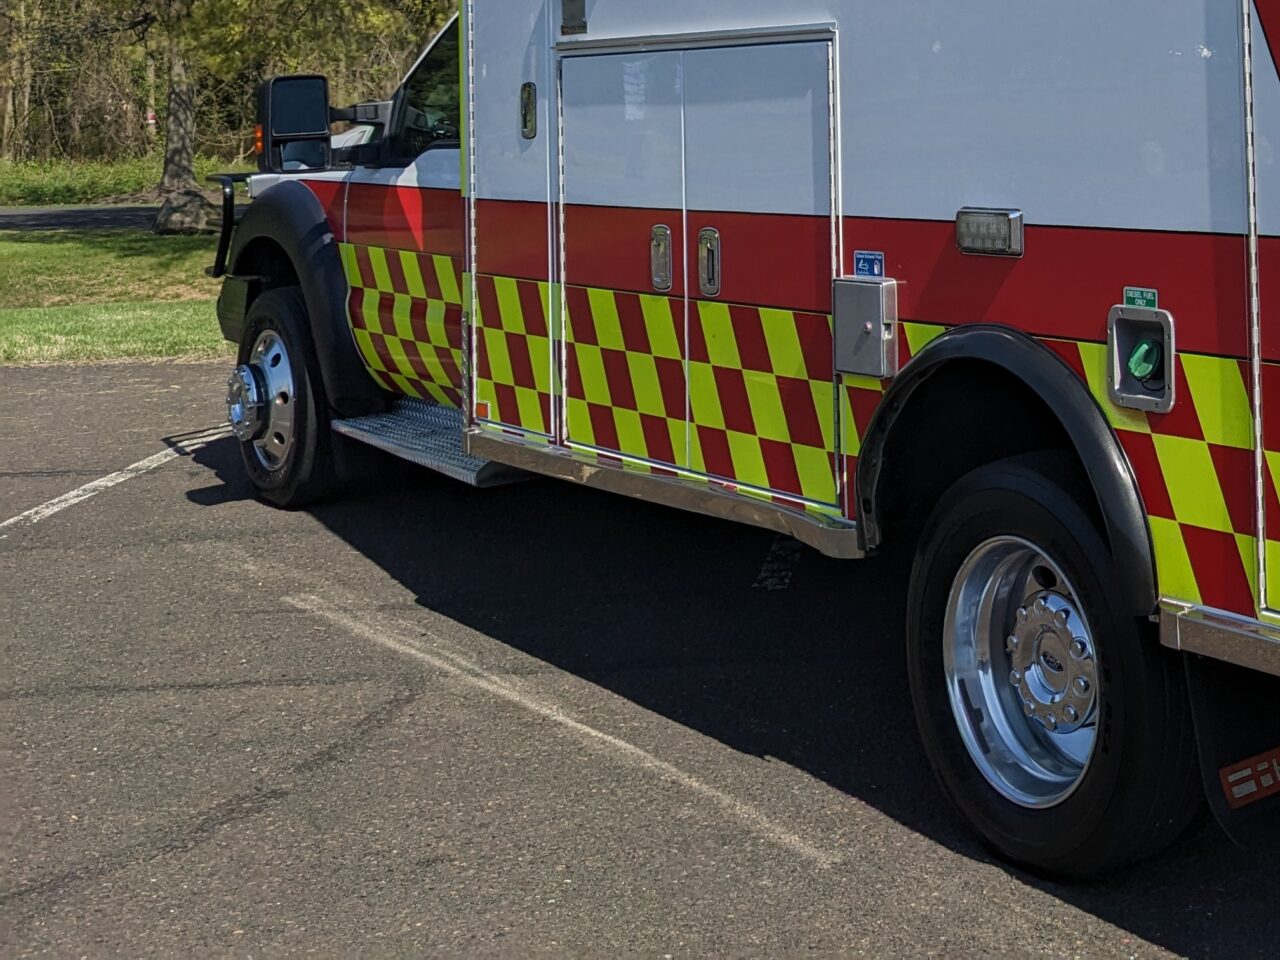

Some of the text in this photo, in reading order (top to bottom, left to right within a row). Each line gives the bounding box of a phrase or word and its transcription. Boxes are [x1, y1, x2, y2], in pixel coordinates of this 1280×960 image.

[1127, 290, 1154, 300] DIESEL FUEL
[1134, 298, 1146, 306] ONLY
